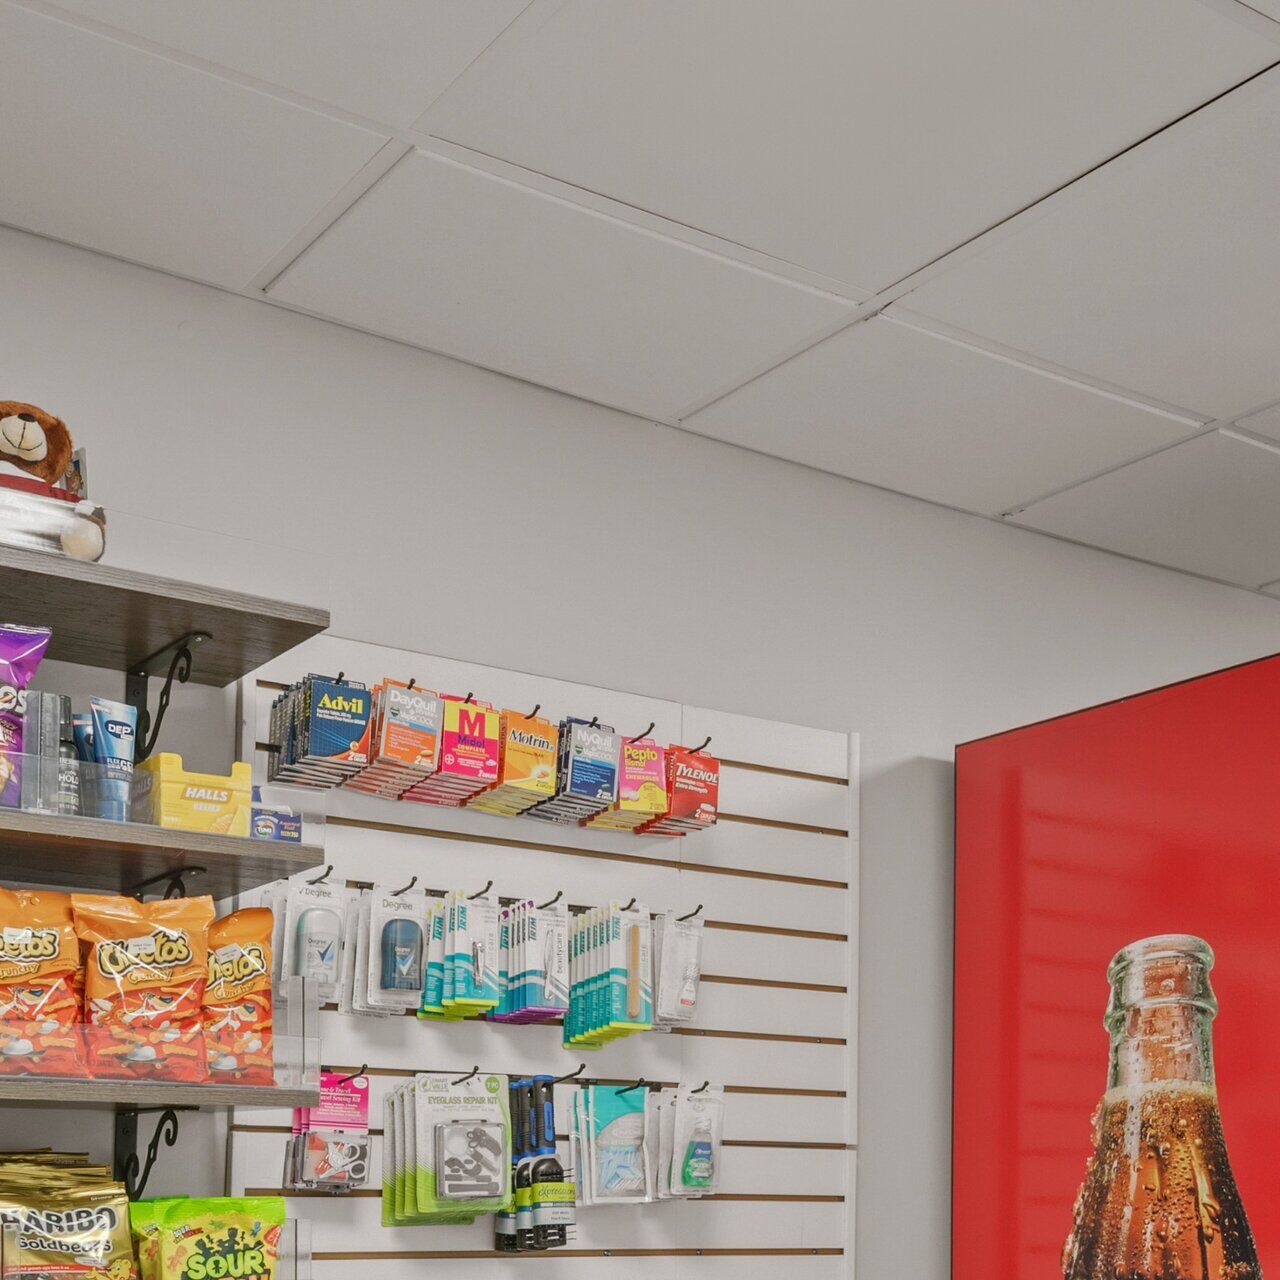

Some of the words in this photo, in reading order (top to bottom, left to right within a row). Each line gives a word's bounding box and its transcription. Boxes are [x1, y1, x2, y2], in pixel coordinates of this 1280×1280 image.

[318, 693, 363, 715] Advil
[390, 689, 437, 713] DayQuil
[107, 723, 132, 736] DEP
[458, 708, 486, 738] M
[457, 735, 486, 749] Midol
[509, 728, 550, 750] Motrin
[576, 729, 614, 748] NyQuil
[623, 745, 659, 762] Pepto
[675, 761, 719, 784] TYLENOL
[185, 786, 229, 803] HALLS
[305, 887, 332, 899] Degree
[382, 898, 414, 912] Degree
[432, 916, 444, 941] TRIM
[457, 905, 468, 931] TRIM
[527, 916, 537, 941] TRIM
[500, 924, 510, 949] TRIM
[428, 1096, 462, 1105] EYEGLASS
[462, 1096, 486, 1105] REPAIR
[486, 1096, 498, 1105] KIT
[0, 1207, 117, 1234] HARIBO
[187, 1250, 265, 1280] SOUR
